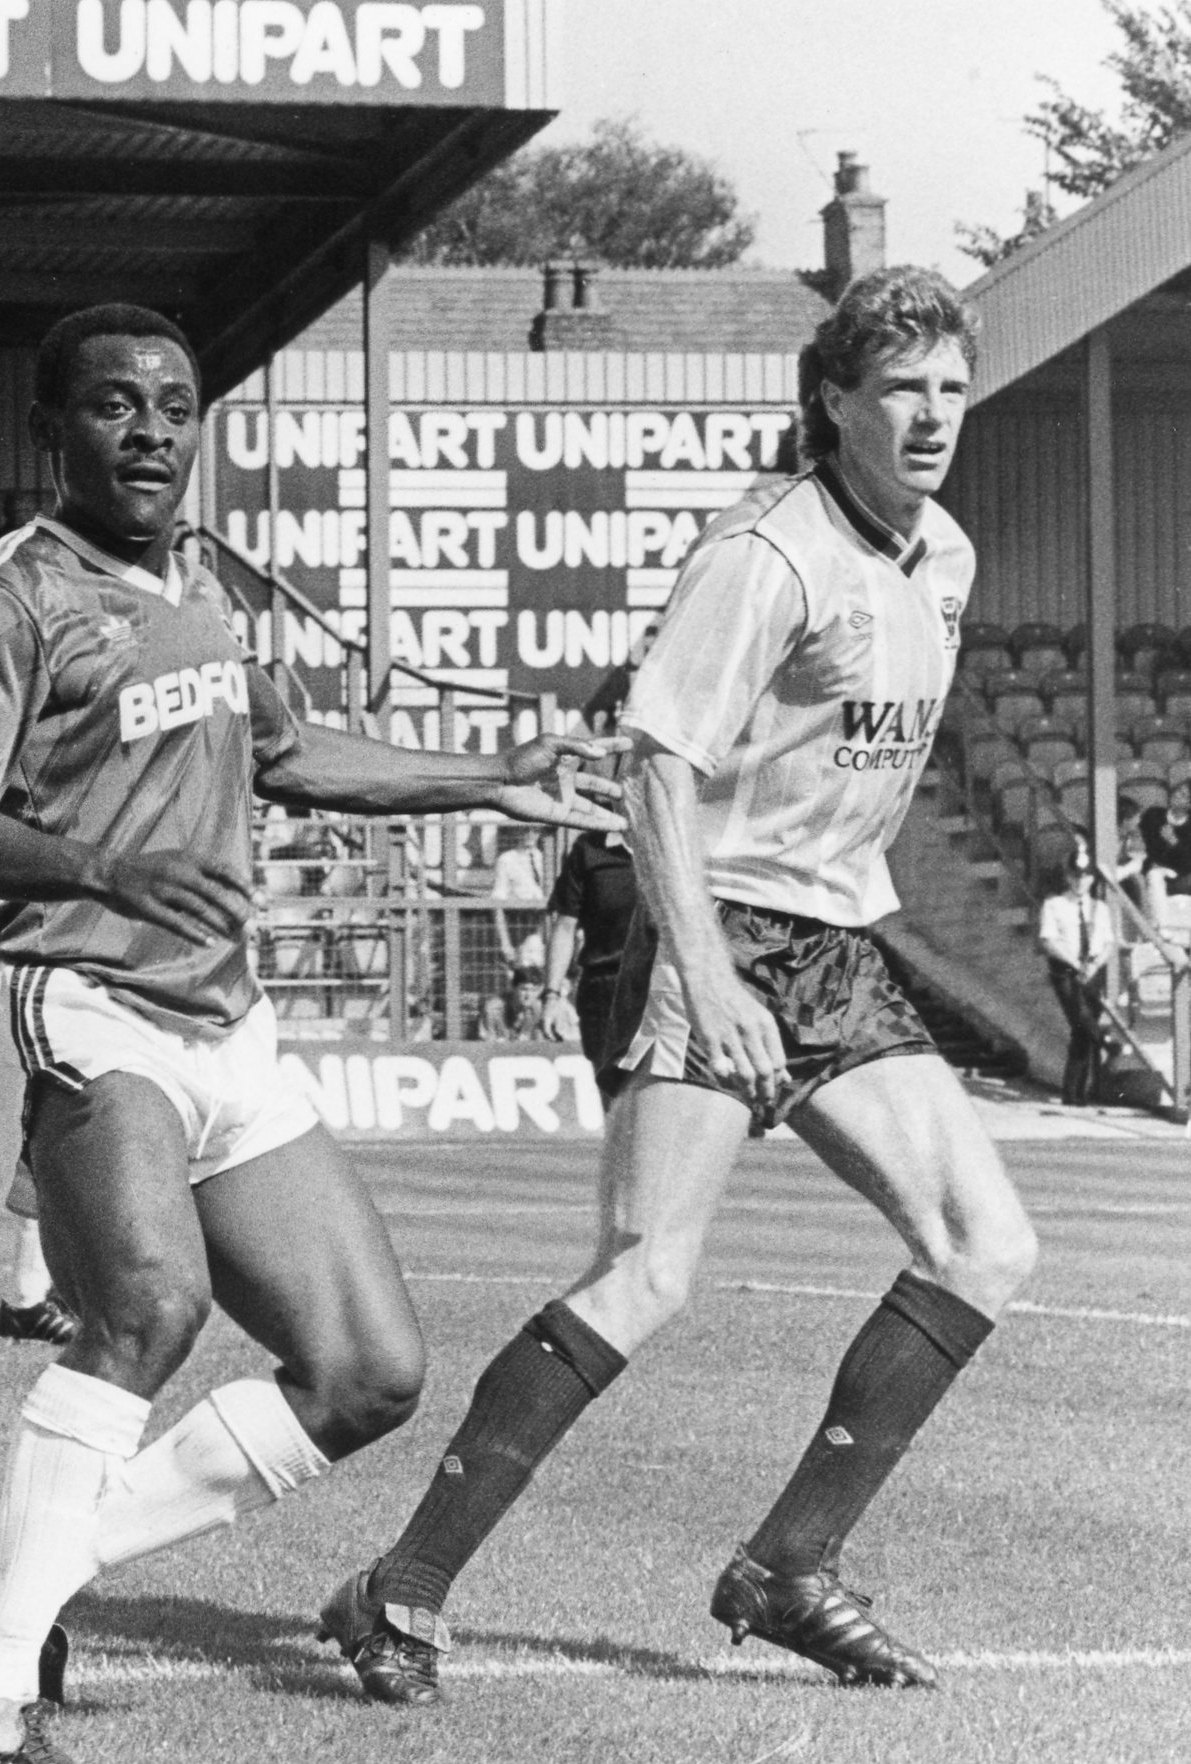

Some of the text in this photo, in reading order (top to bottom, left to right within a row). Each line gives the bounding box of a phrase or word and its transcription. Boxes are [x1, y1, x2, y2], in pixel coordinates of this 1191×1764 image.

[77, 0, 485, 89] UNIPART
[516, 412, 791, 470] UNIPART
[517, 510, 720, 570] UNIPA
[119, 660, 249, 742] BEDFO
[842, 698, 937, 744] WAN
[277, 1053, 606, 1131] NIPART
